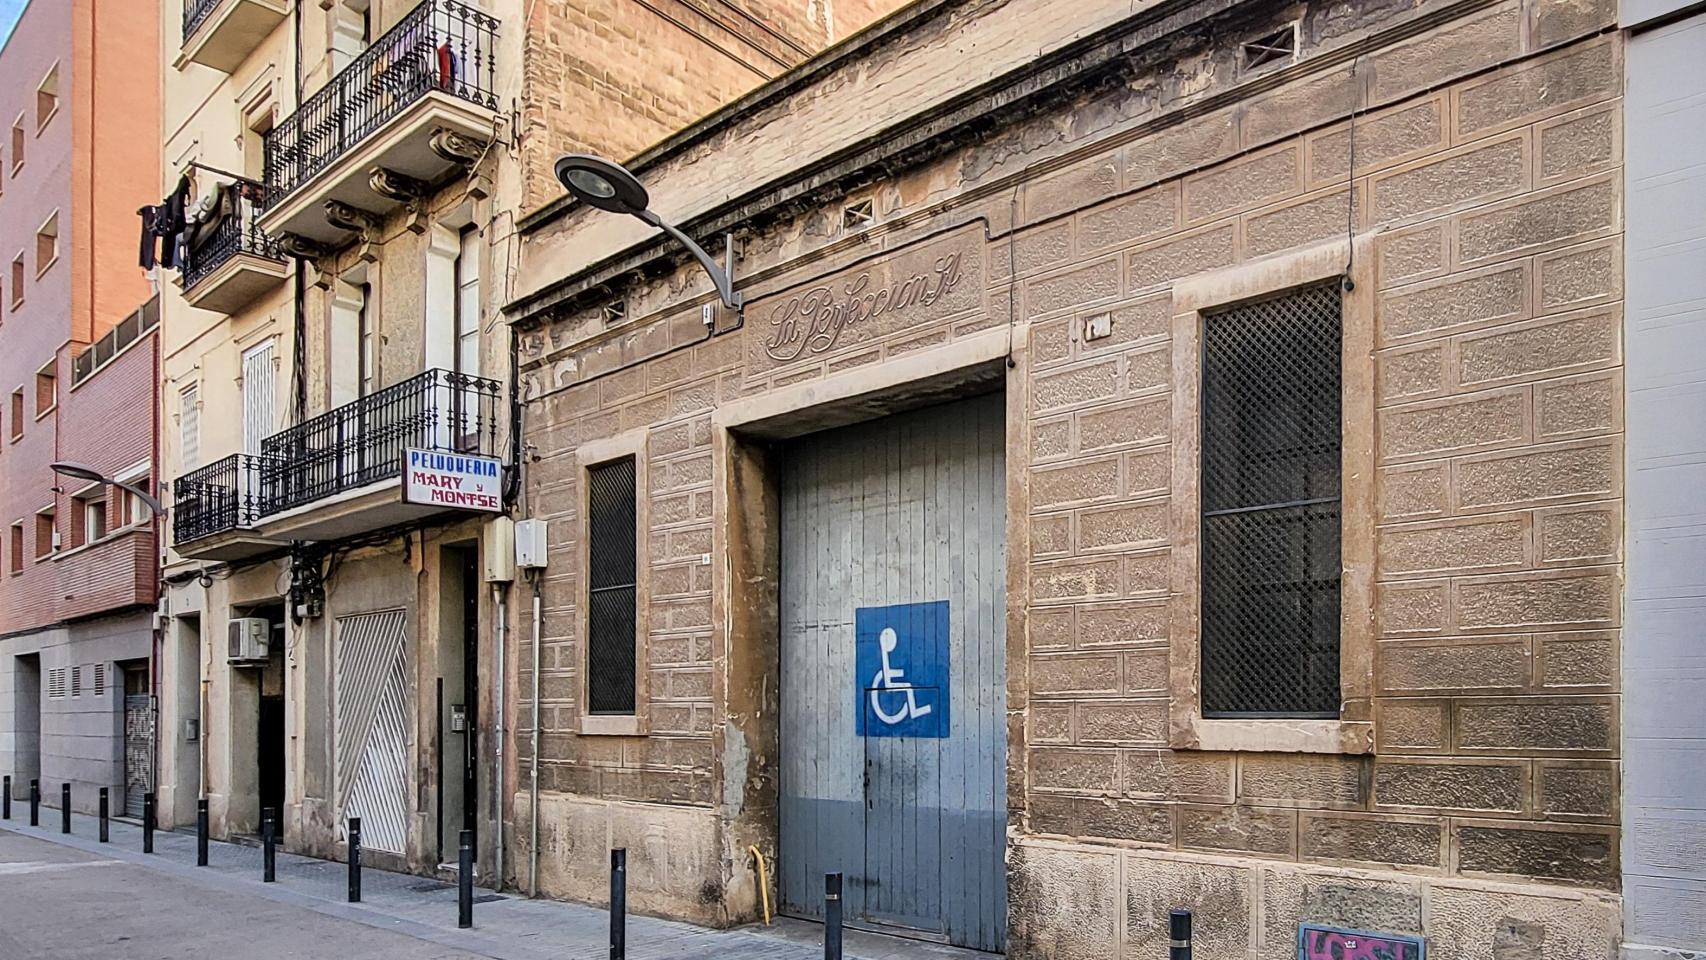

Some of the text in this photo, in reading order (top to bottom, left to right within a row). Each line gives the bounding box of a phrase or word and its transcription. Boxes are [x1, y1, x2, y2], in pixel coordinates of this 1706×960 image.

[767, 297, 802, 349] La
[412, 452, 496, 477] PELUQUERIA
[414, 472, 463, 489] MARY
[432, 489, 498, 507] MONTSE
